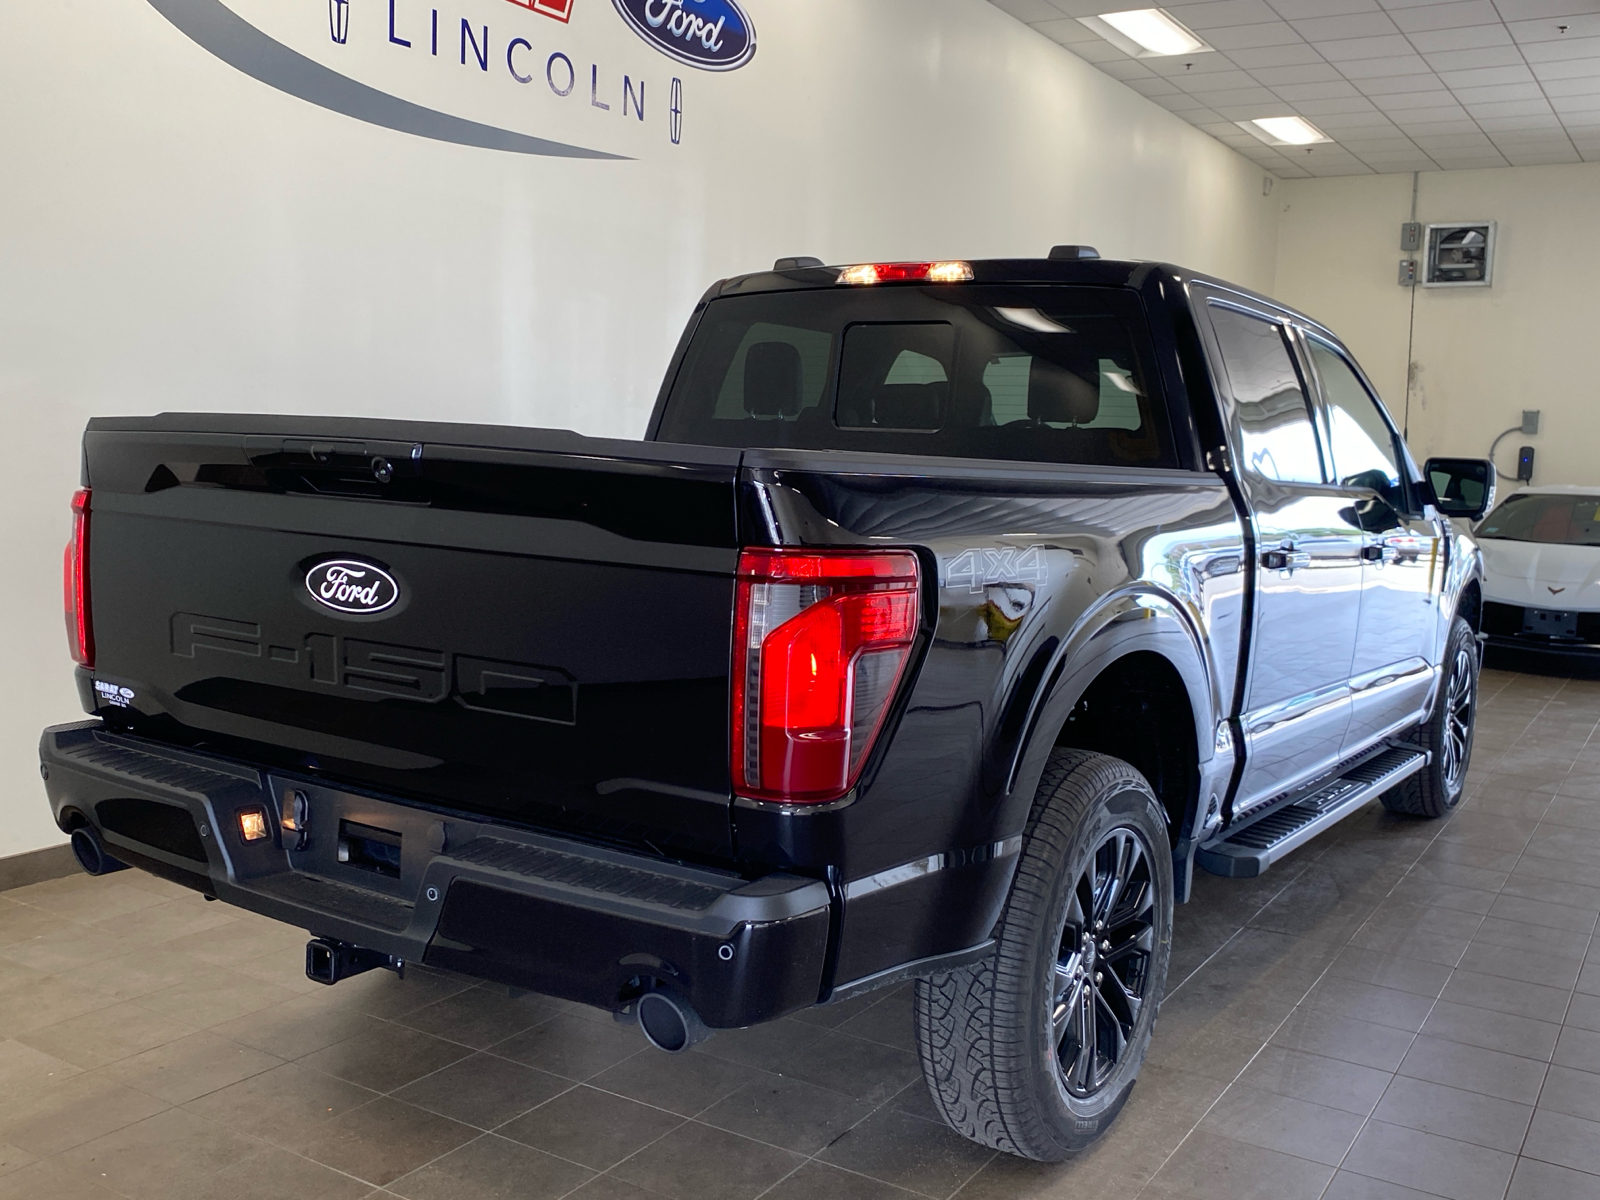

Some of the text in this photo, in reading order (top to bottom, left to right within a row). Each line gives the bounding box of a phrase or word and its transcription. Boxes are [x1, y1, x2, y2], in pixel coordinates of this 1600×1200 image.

[389, 0, 645, 121] LINCOLN
[319, 566, 381, 605] Ford
[101, 691, 130, 704] LINCOLN
[170, 612, 577, 725] F-150
